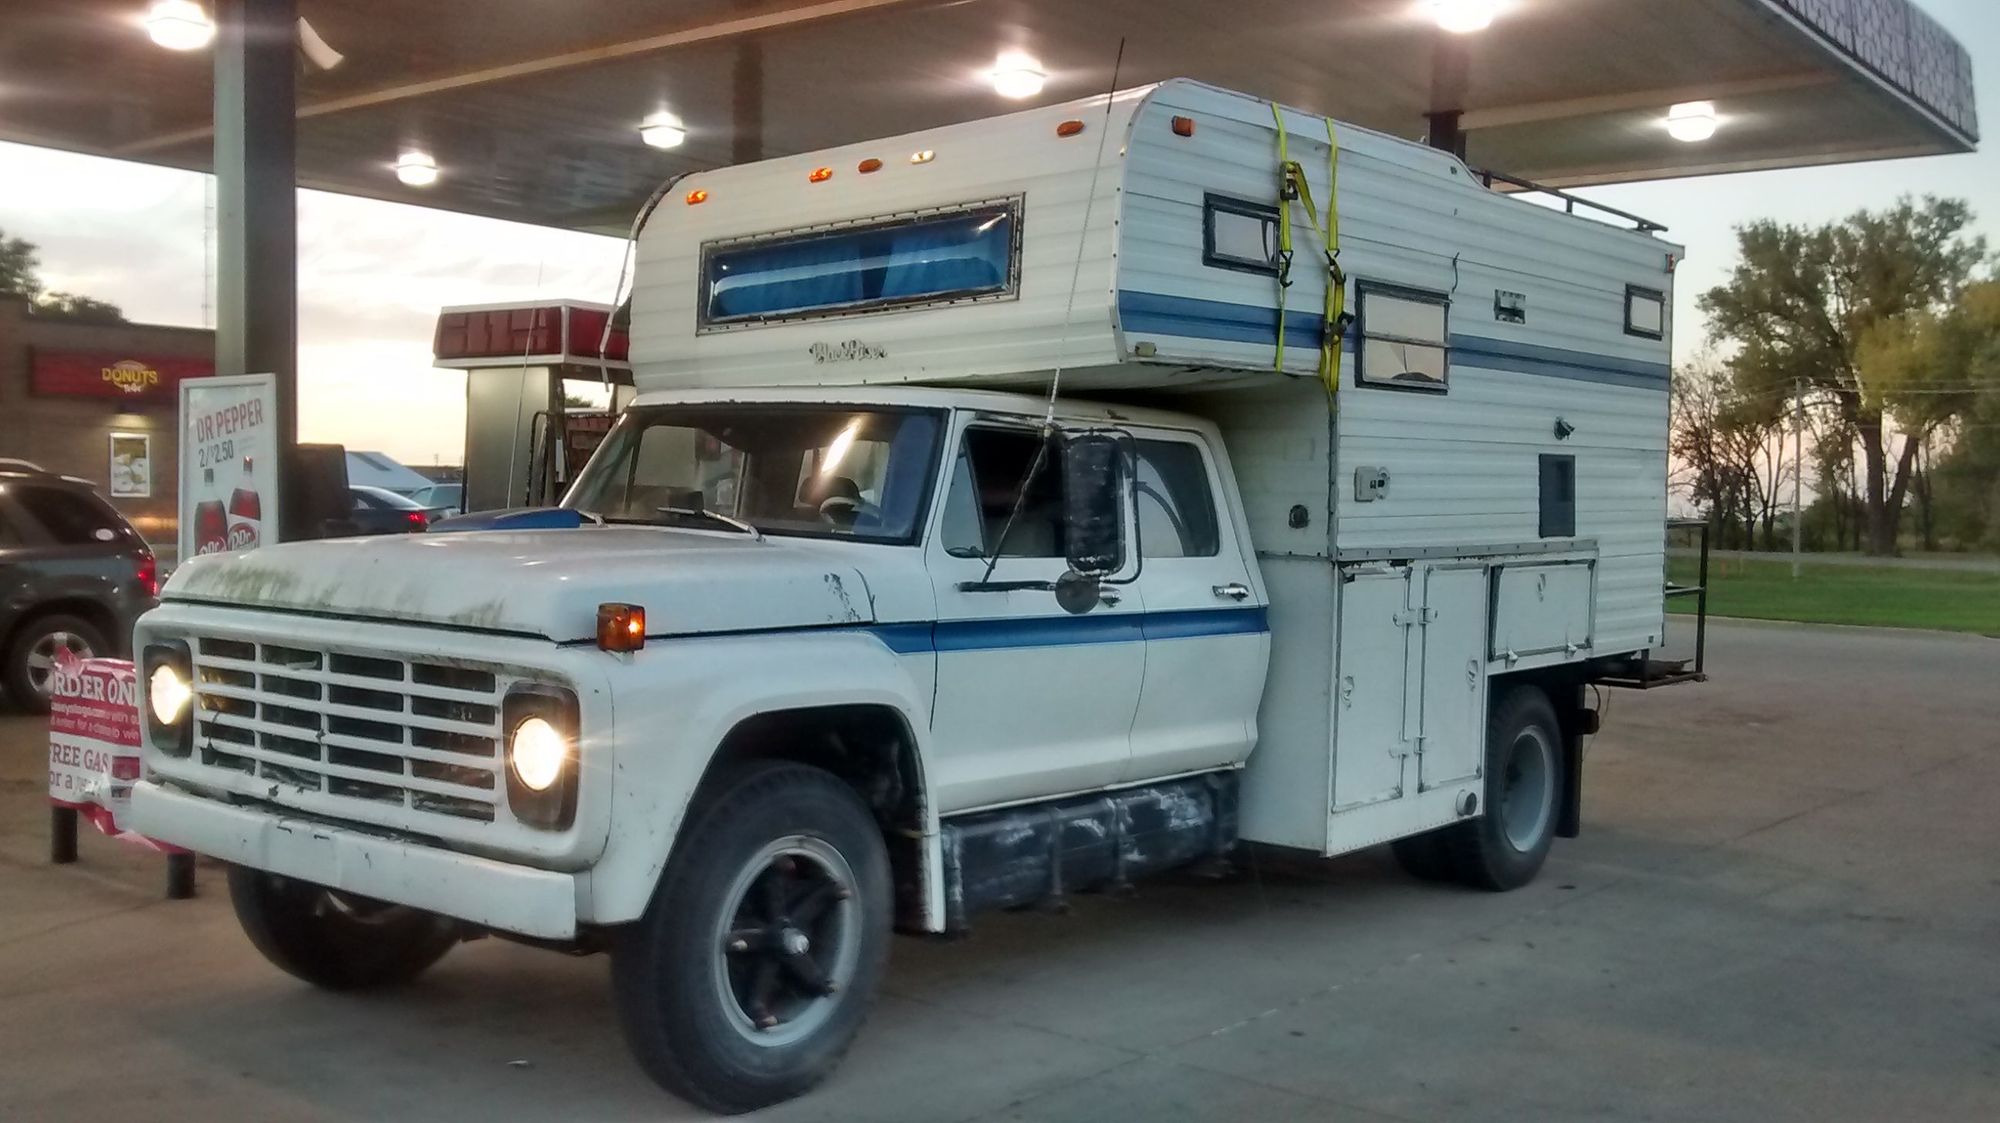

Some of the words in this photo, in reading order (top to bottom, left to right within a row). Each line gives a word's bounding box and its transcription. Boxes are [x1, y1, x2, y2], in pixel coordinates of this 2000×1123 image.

[102, 367, 158, 385] DONUTS
[197, 414, 214, 443] DR
[216, 398, 263, 437] PEPPER
[52, 671, 105, 702] RDER
[107, 678, 136, 707] ON
[50, 742, 80, 768] REE
[84, 749, 109, 773] GAS
[49, 770, 62, 787] or
